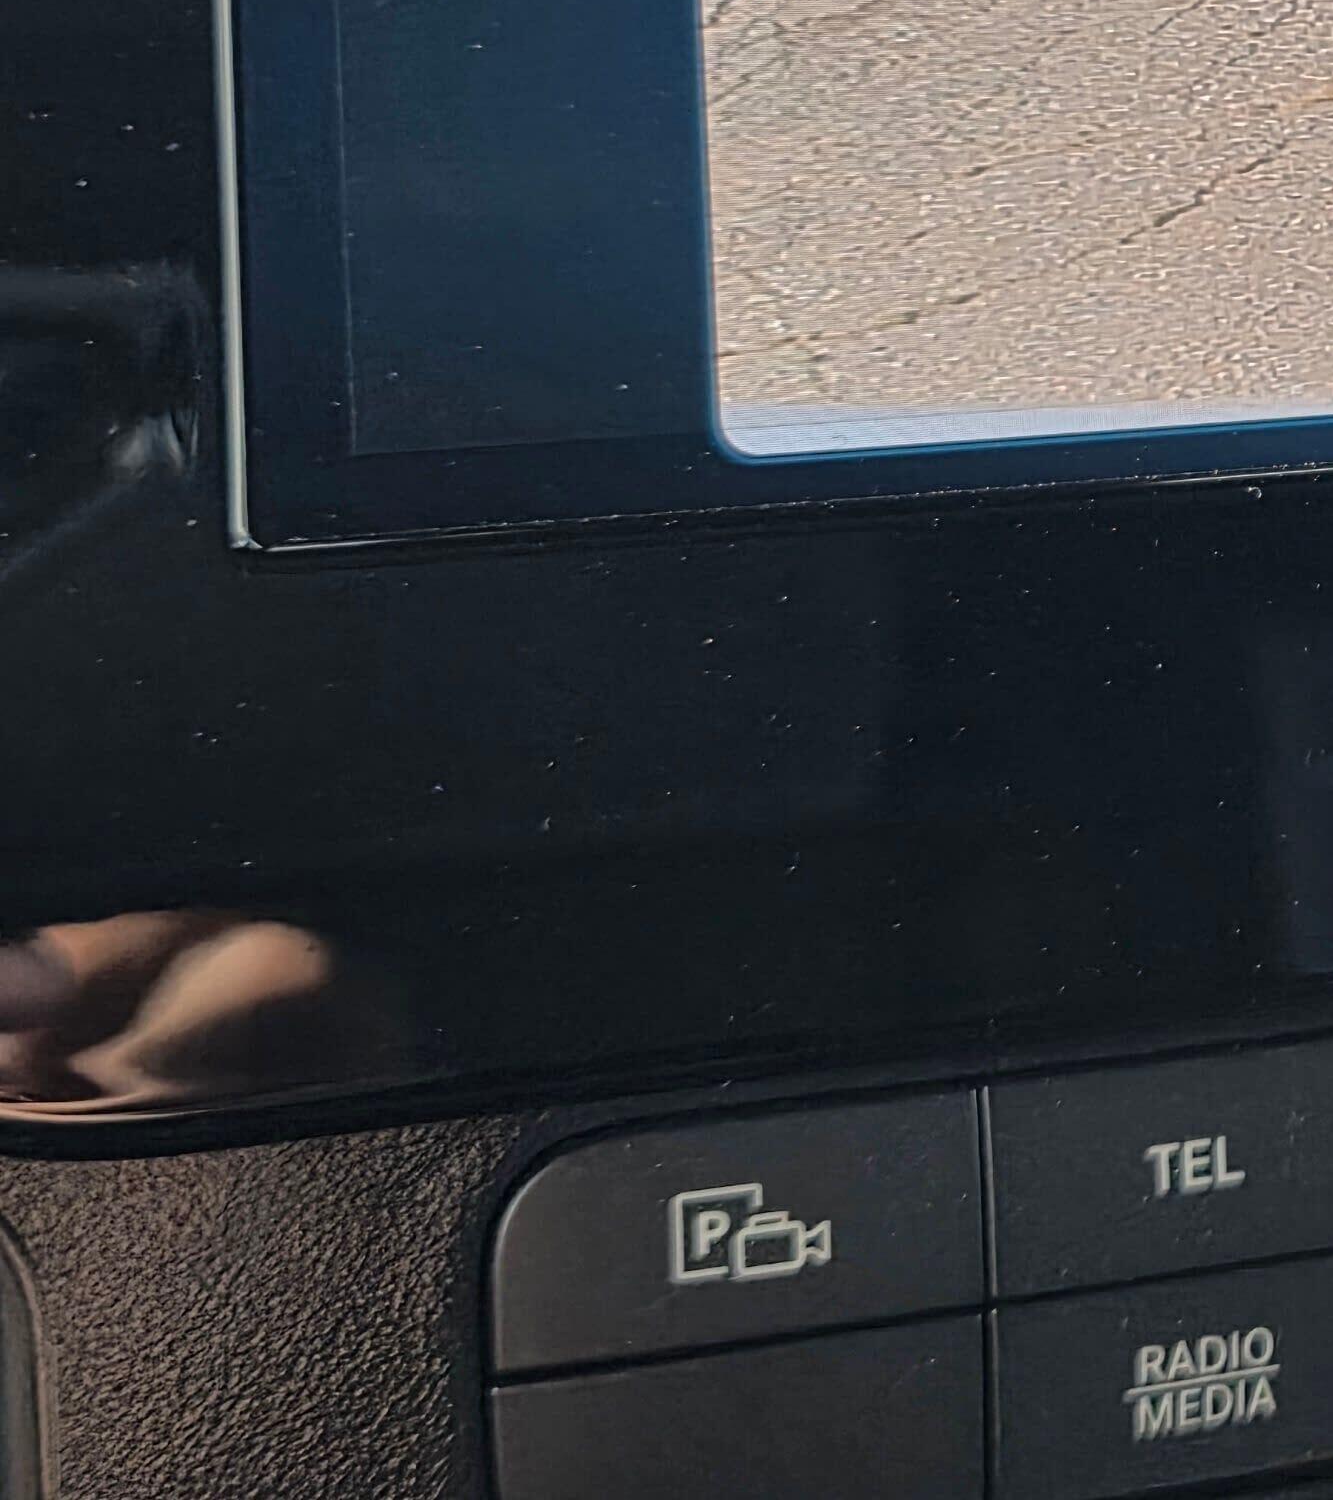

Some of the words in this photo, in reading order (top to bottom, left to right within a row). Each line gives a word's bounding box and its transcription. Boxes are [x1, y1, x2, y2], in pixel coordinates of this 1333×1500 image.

[1143, 1135, 1246, 1197] TEL
[1134, 1326, 1275, 1387] RADIO
[1132, 1376, 1277, 1442] MEDIA
